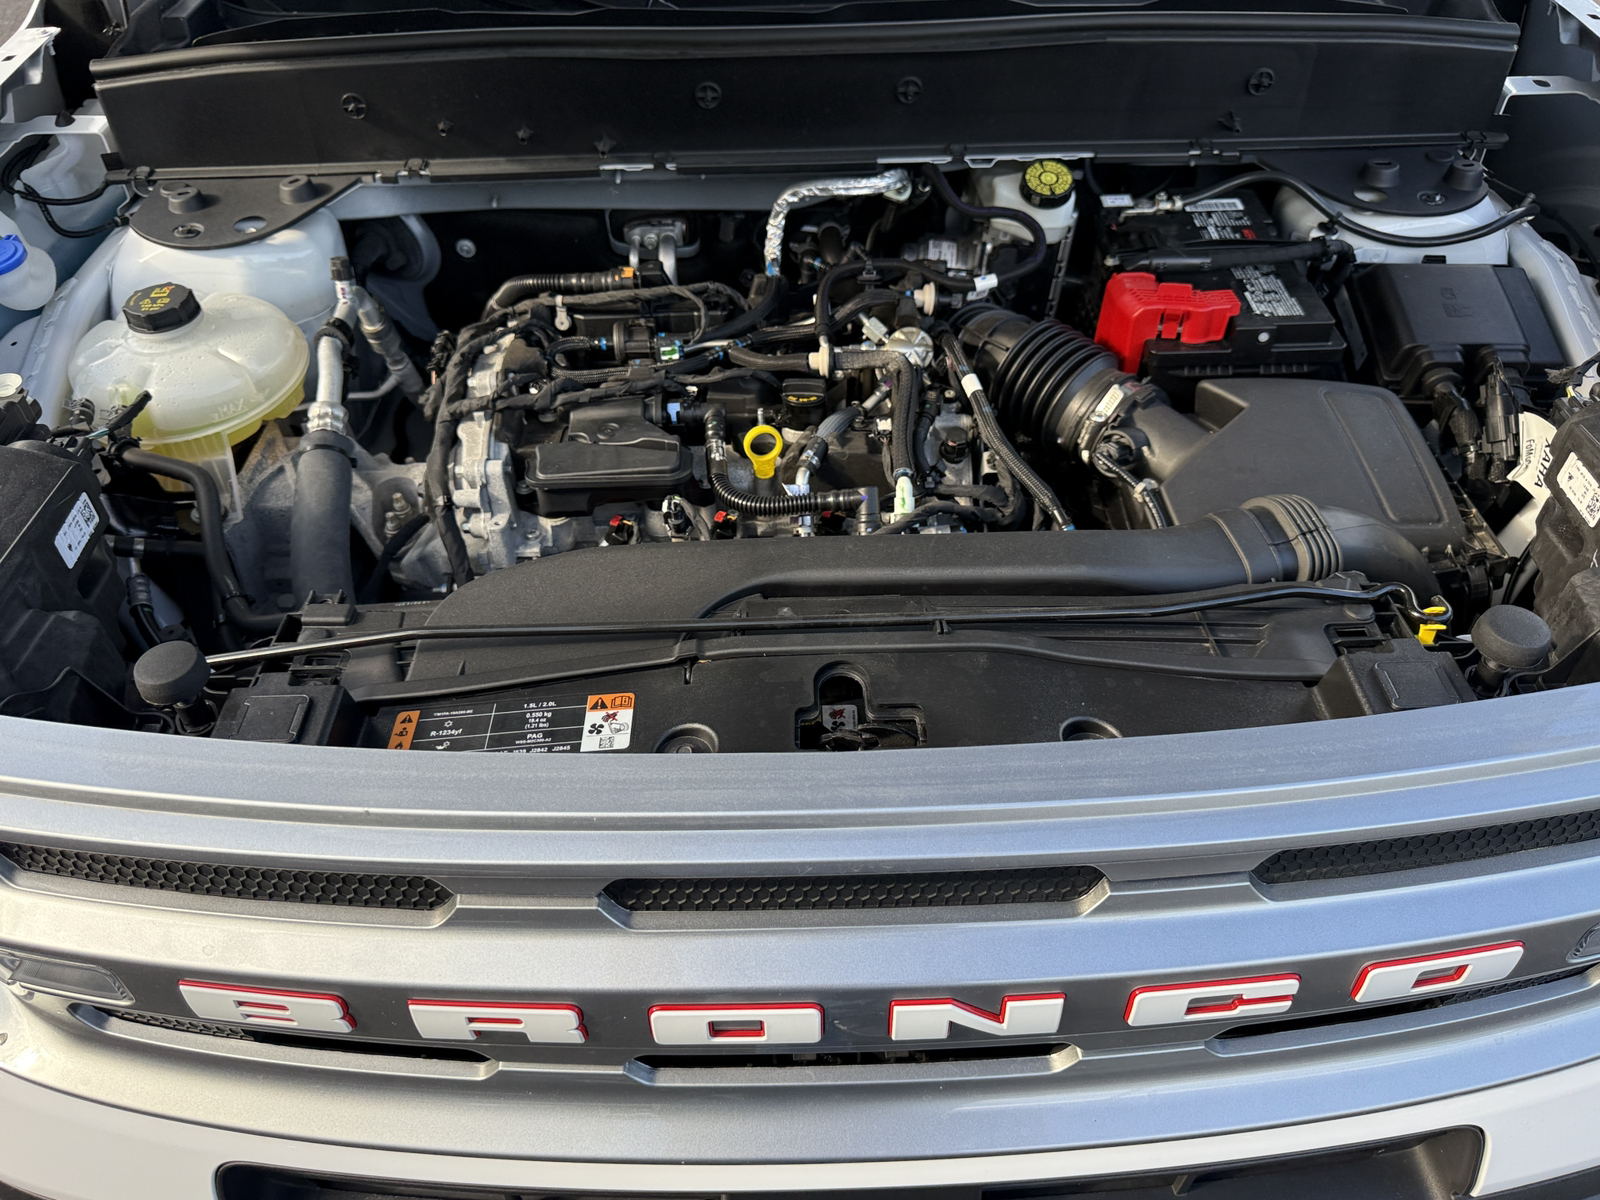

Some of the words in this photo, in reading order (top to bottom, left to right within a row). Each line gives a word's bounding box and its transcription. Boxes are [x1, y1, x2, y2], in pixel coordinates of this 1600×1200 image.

[525, 711, 543, 719] 0.550
[430, 728, 463, 737] R-1234yf
[179, 940, 1526, 1046] BRONCO
